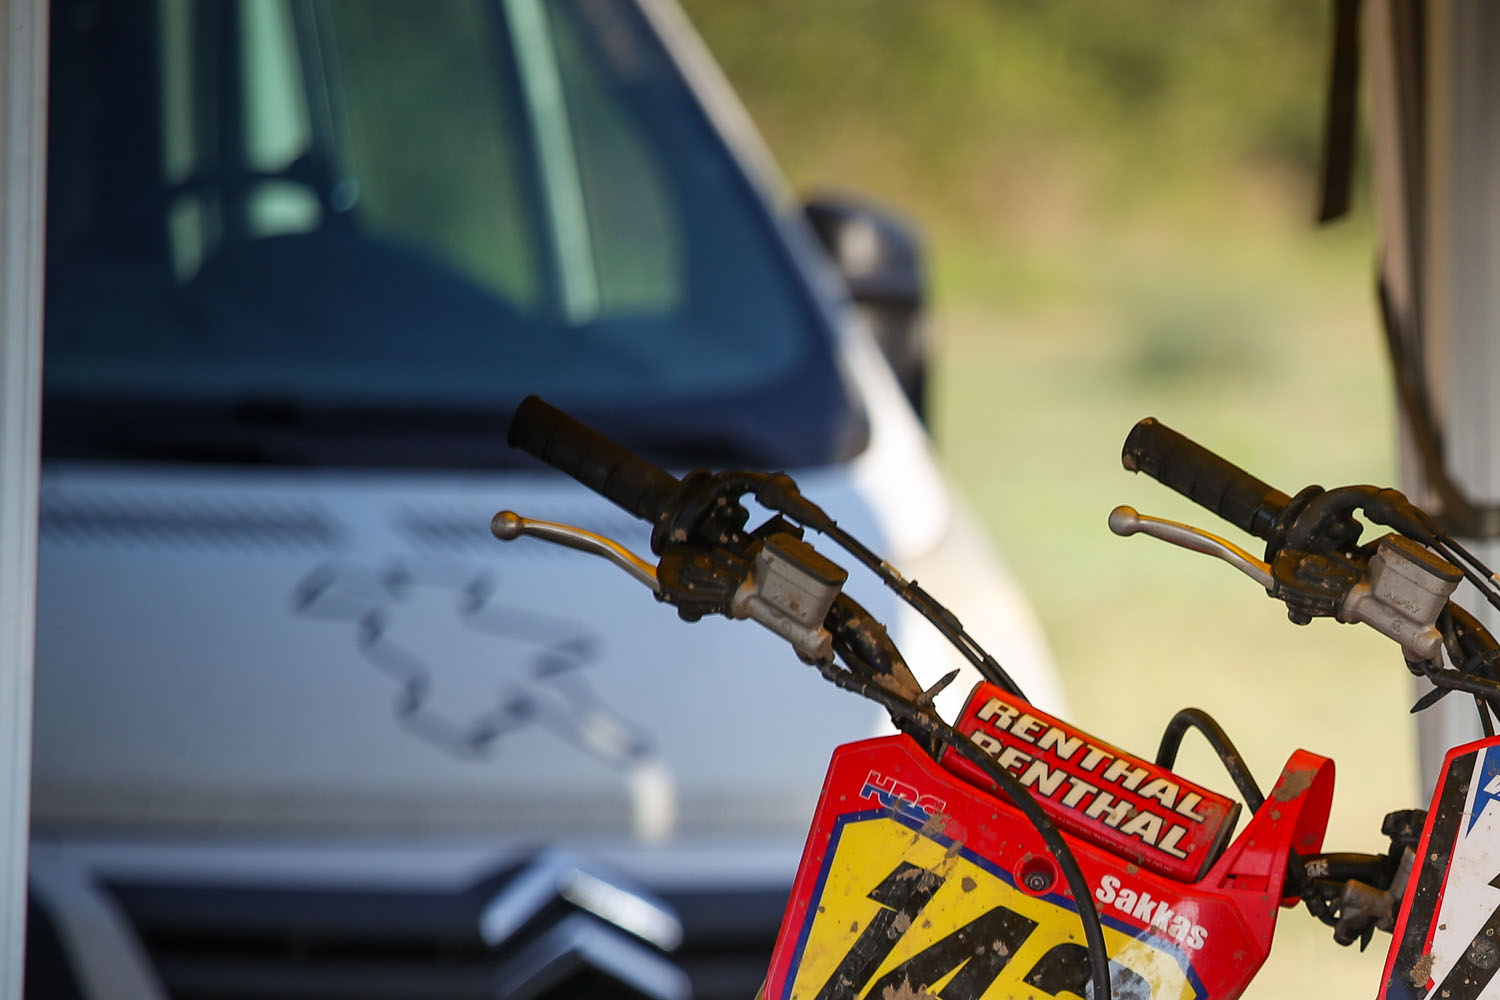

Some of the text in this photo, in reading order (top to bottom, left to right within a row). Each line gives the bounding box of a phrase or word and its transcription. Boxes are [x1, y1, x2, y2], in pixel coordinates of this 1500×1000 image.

[970, 730, 1189, 860] RENTHAL
[976, 697, 1207, 824] RENTHAL
[1095, 876, 1209, 951] Sakkas
